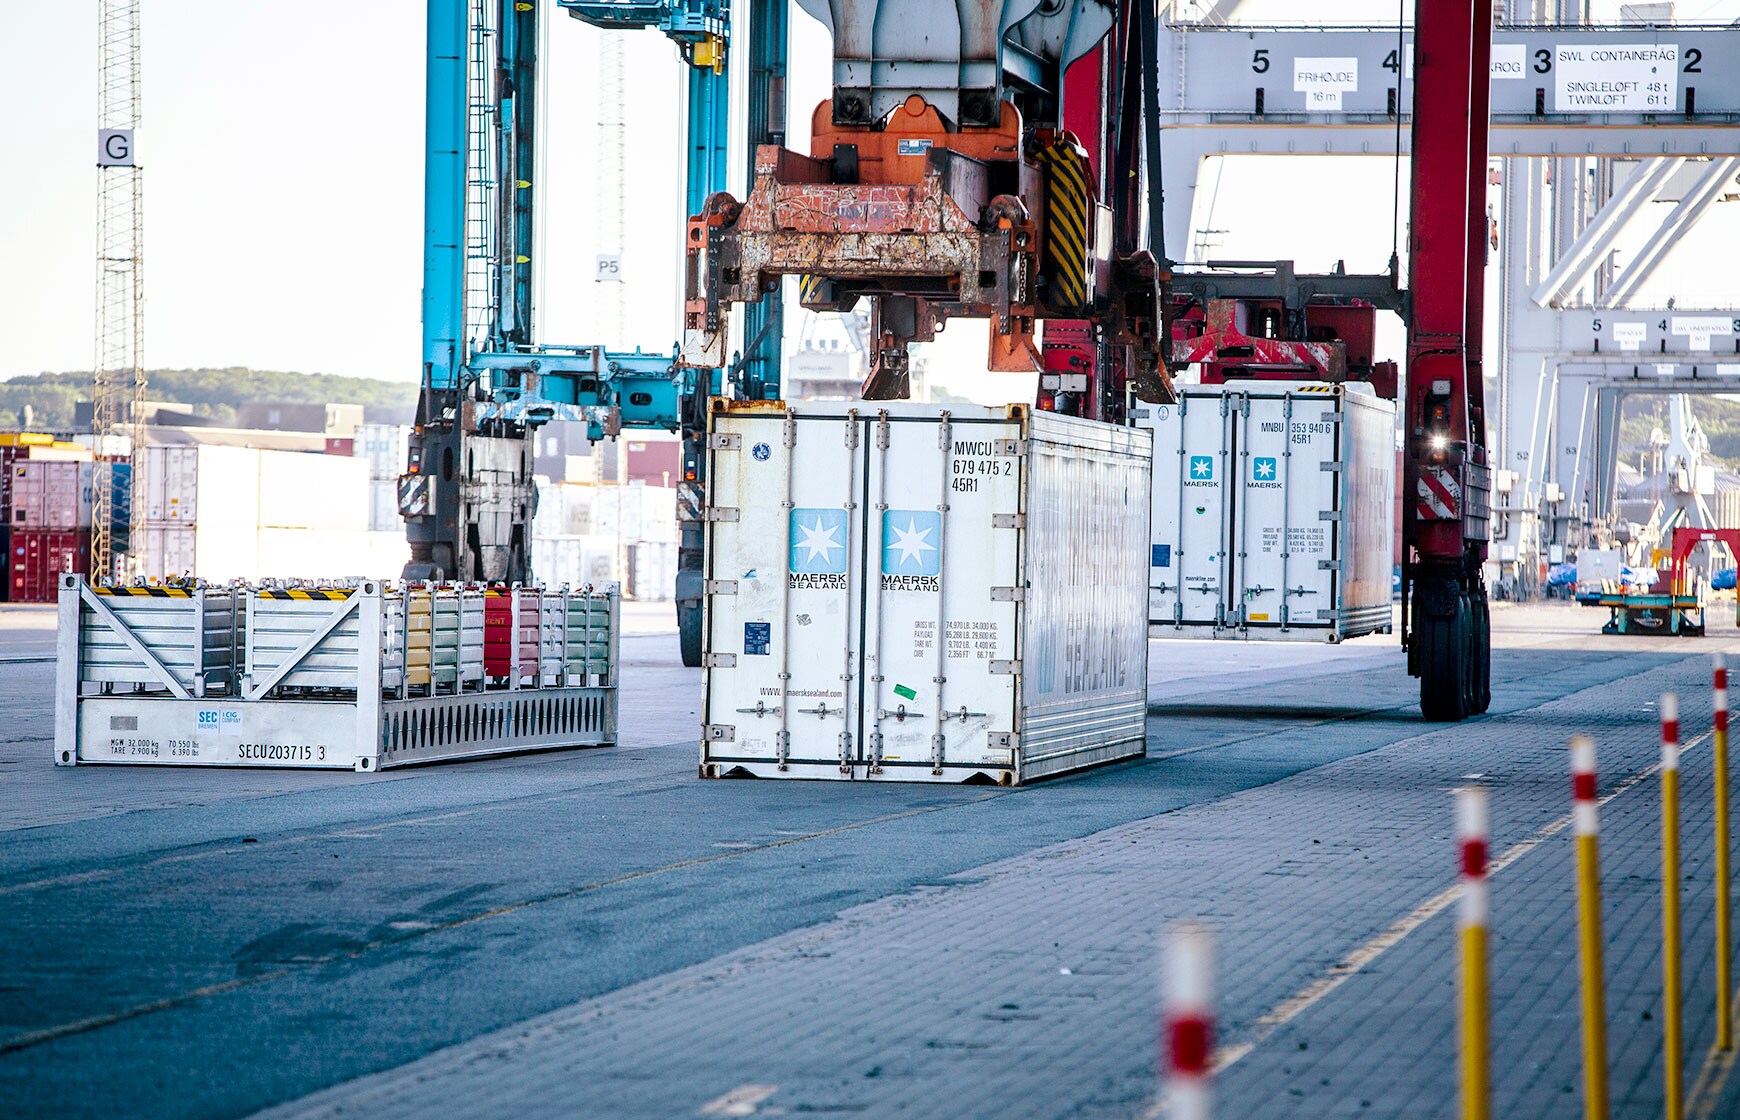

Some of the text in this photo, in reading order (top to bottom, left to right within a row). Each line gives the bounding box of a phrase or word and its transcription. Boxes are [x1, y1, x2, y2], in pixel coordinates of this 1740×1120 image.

[1382, 50, 1399, 73] 4
[1533, 49, 1552, 74] 3
[1559, 48, 1676, 62] SWL CONTAINERÅG
[1683, 48, 1702, 73] 2
[1252, 50, 1270, 74] 5
[1298, 72, 1354, 83] FRIHØJDE
[1567, 82, 1668, 92] SINGLELØFT 48 t
[1314, 92, 1336, 102] 16 m
[1568, 94, 1668, 105] TWINLØFT 61 t
[106, 134, 128, 160] G
[599, 260, 619, 273] P5
[1592, 319, 1602, 332] 5
[1658, 319, 1667, 332] 4
[1261, 422, 1331, 434] MNBU 353 940 6
[1292, 434, 1311, 444] 45R1
[954, 441, 992, 456] MWCU
[954, 460, 1012, 476] 679 475 2
[952, 478, 978, 492] 45R1
[790, 574, 846, 582] MAERSK
[882, 575, 938, 585] MAERSK
[881, 584, 939, 592] SEALAND
[199, 711, 218, 723] SEC
[152, 740, 159, 749] kg
[152, 749, 159, 757] kg
[319, 746, 325, 760] 3
